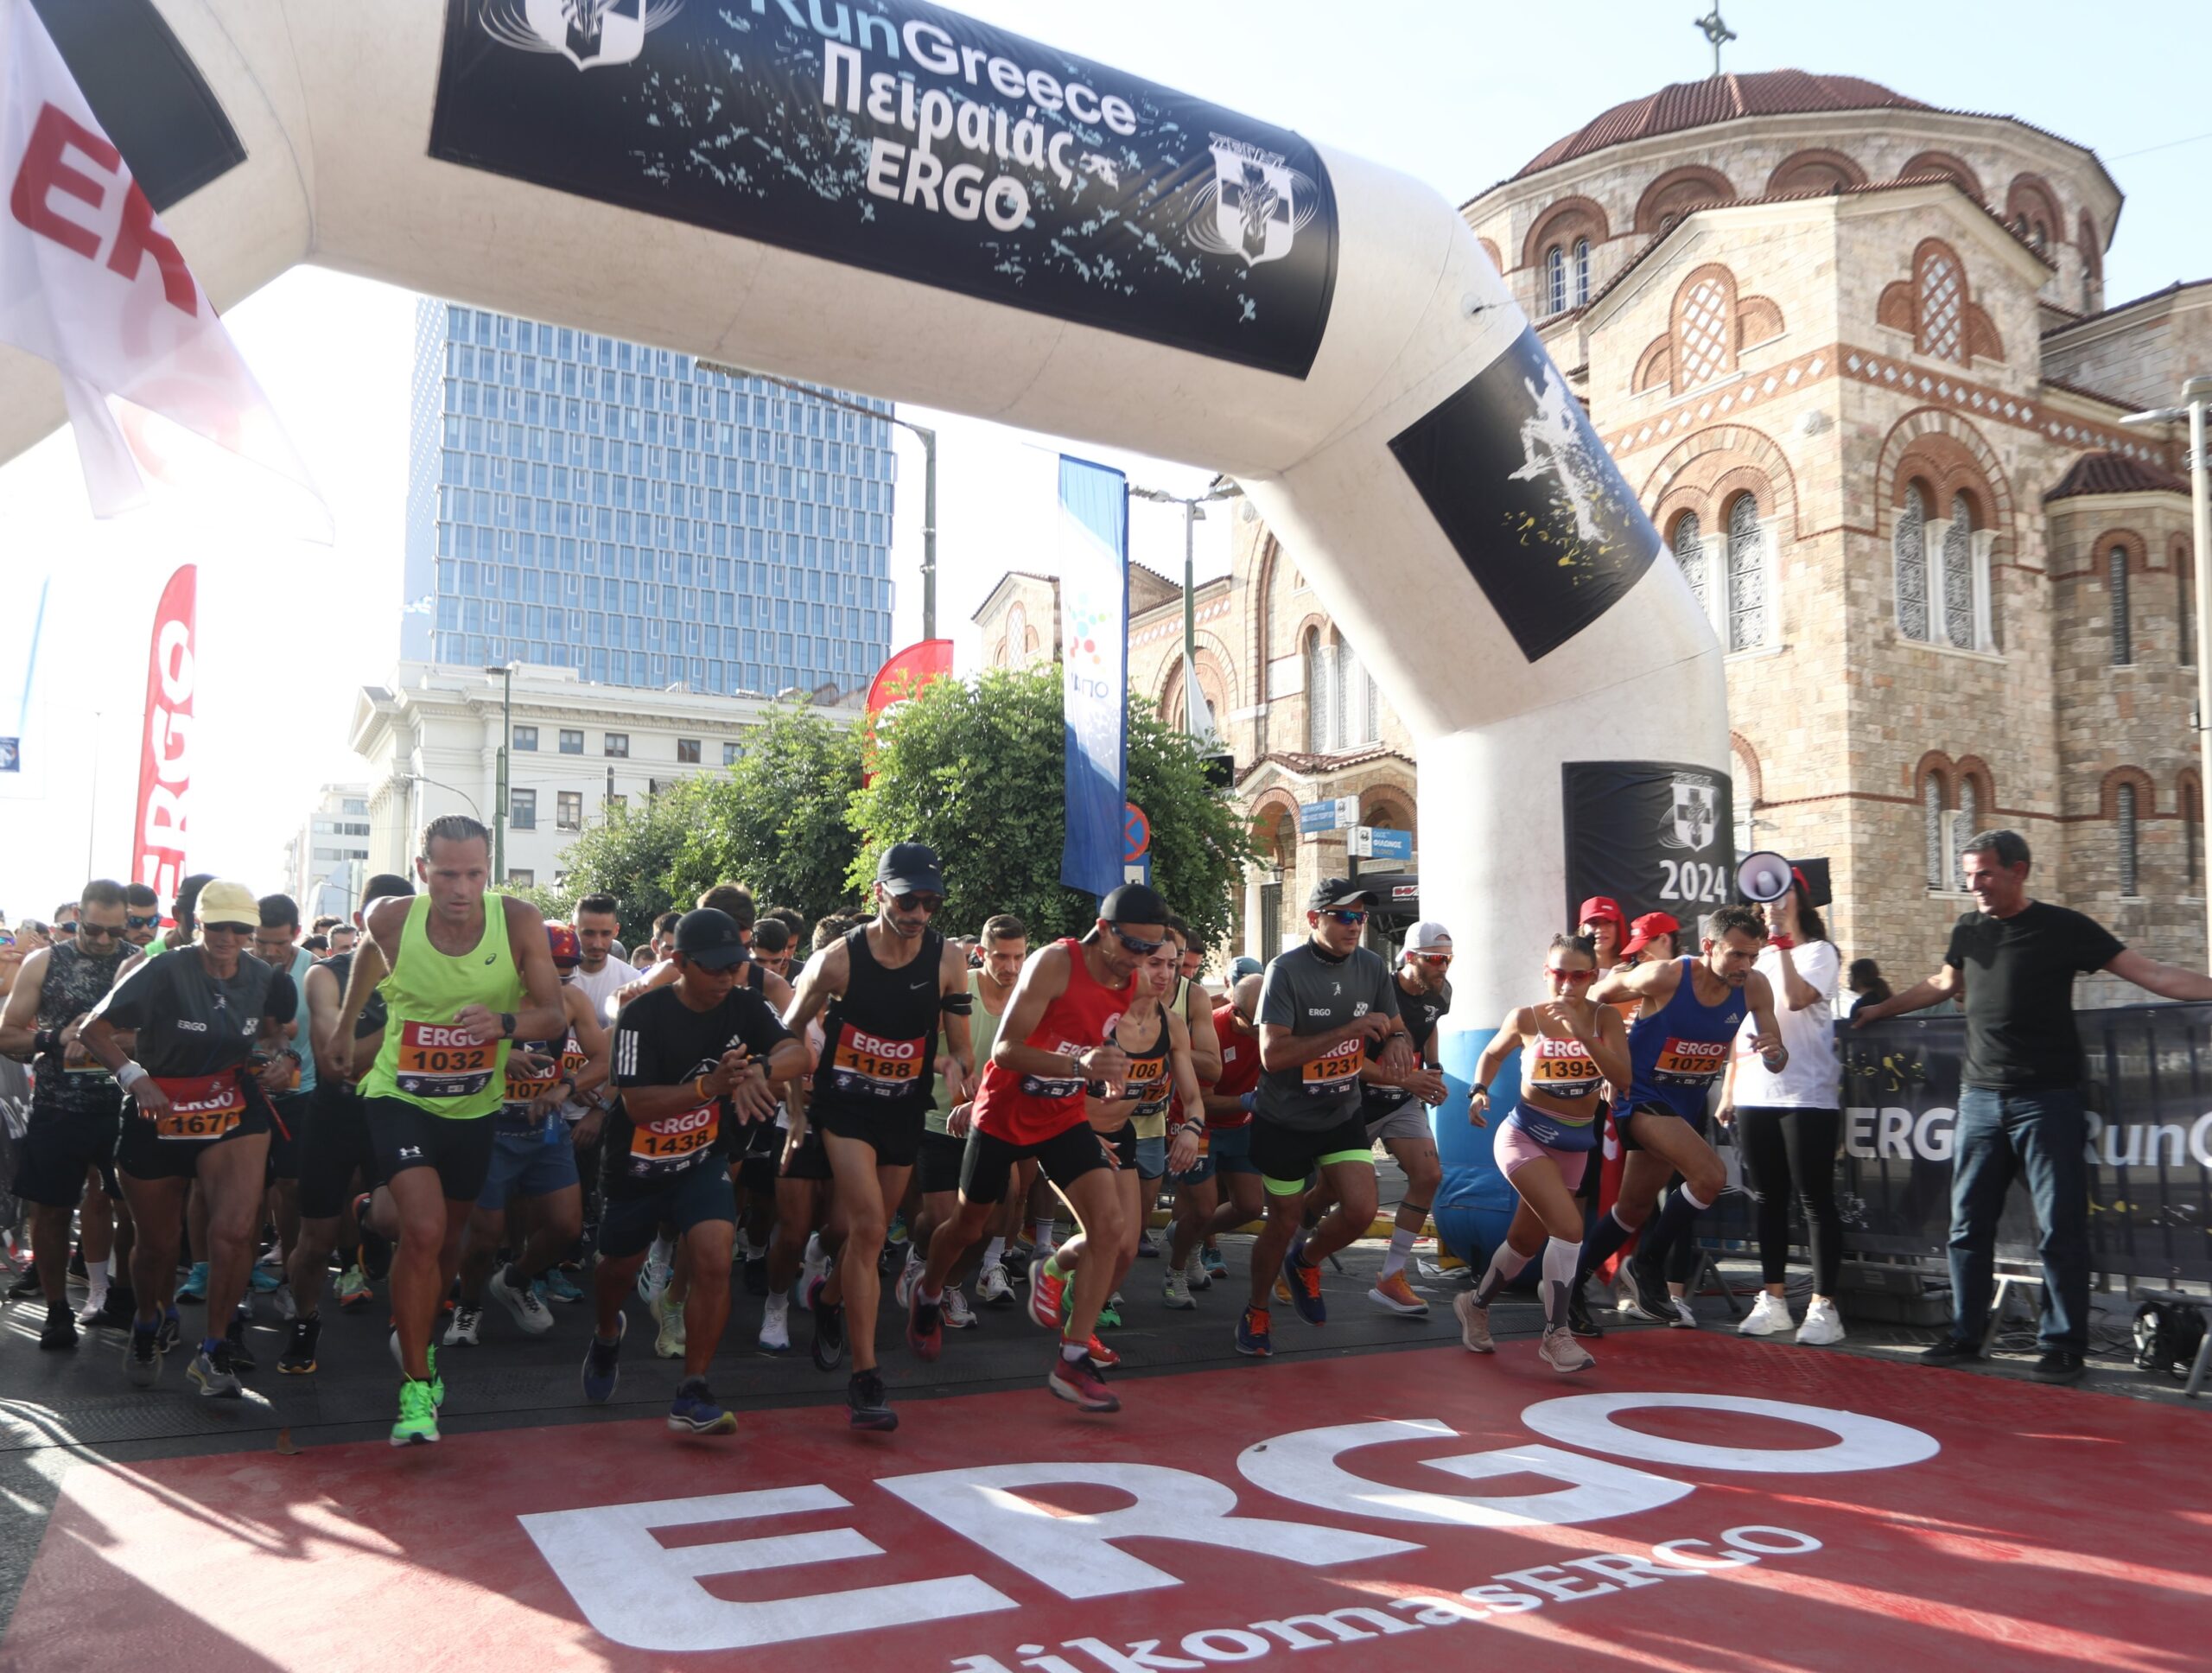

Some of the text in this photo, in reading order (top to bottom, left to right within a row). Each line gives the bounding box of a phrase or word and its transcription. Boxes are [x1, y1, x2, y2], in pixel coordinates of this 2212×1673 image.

[823, 39, 1074, 189] Πειραιάς
[867, 137, 1030, 232] ERGO
[1659, 860, 1726, 904] 2024
[1308, 1008, 1331, 1016] ERGO
[178, 1020, 207, 1032] ERGO
[852, 1032, 914, 1059] ERGO
[1675, 1041, 1724, 1056] ERGO
[413, 1051, 485, 1071] 1032
[848, 1053, 911, 1078] 1188
[1313, 1055, 1357, 1078] 1231
[1541, 1061, 1597, 1078] 1395
[1669, 1057, 1717, 1071] 1073
[645, 1130, 708, 1155] 1438
[517, 1392, 1942, 1652] ERGO
